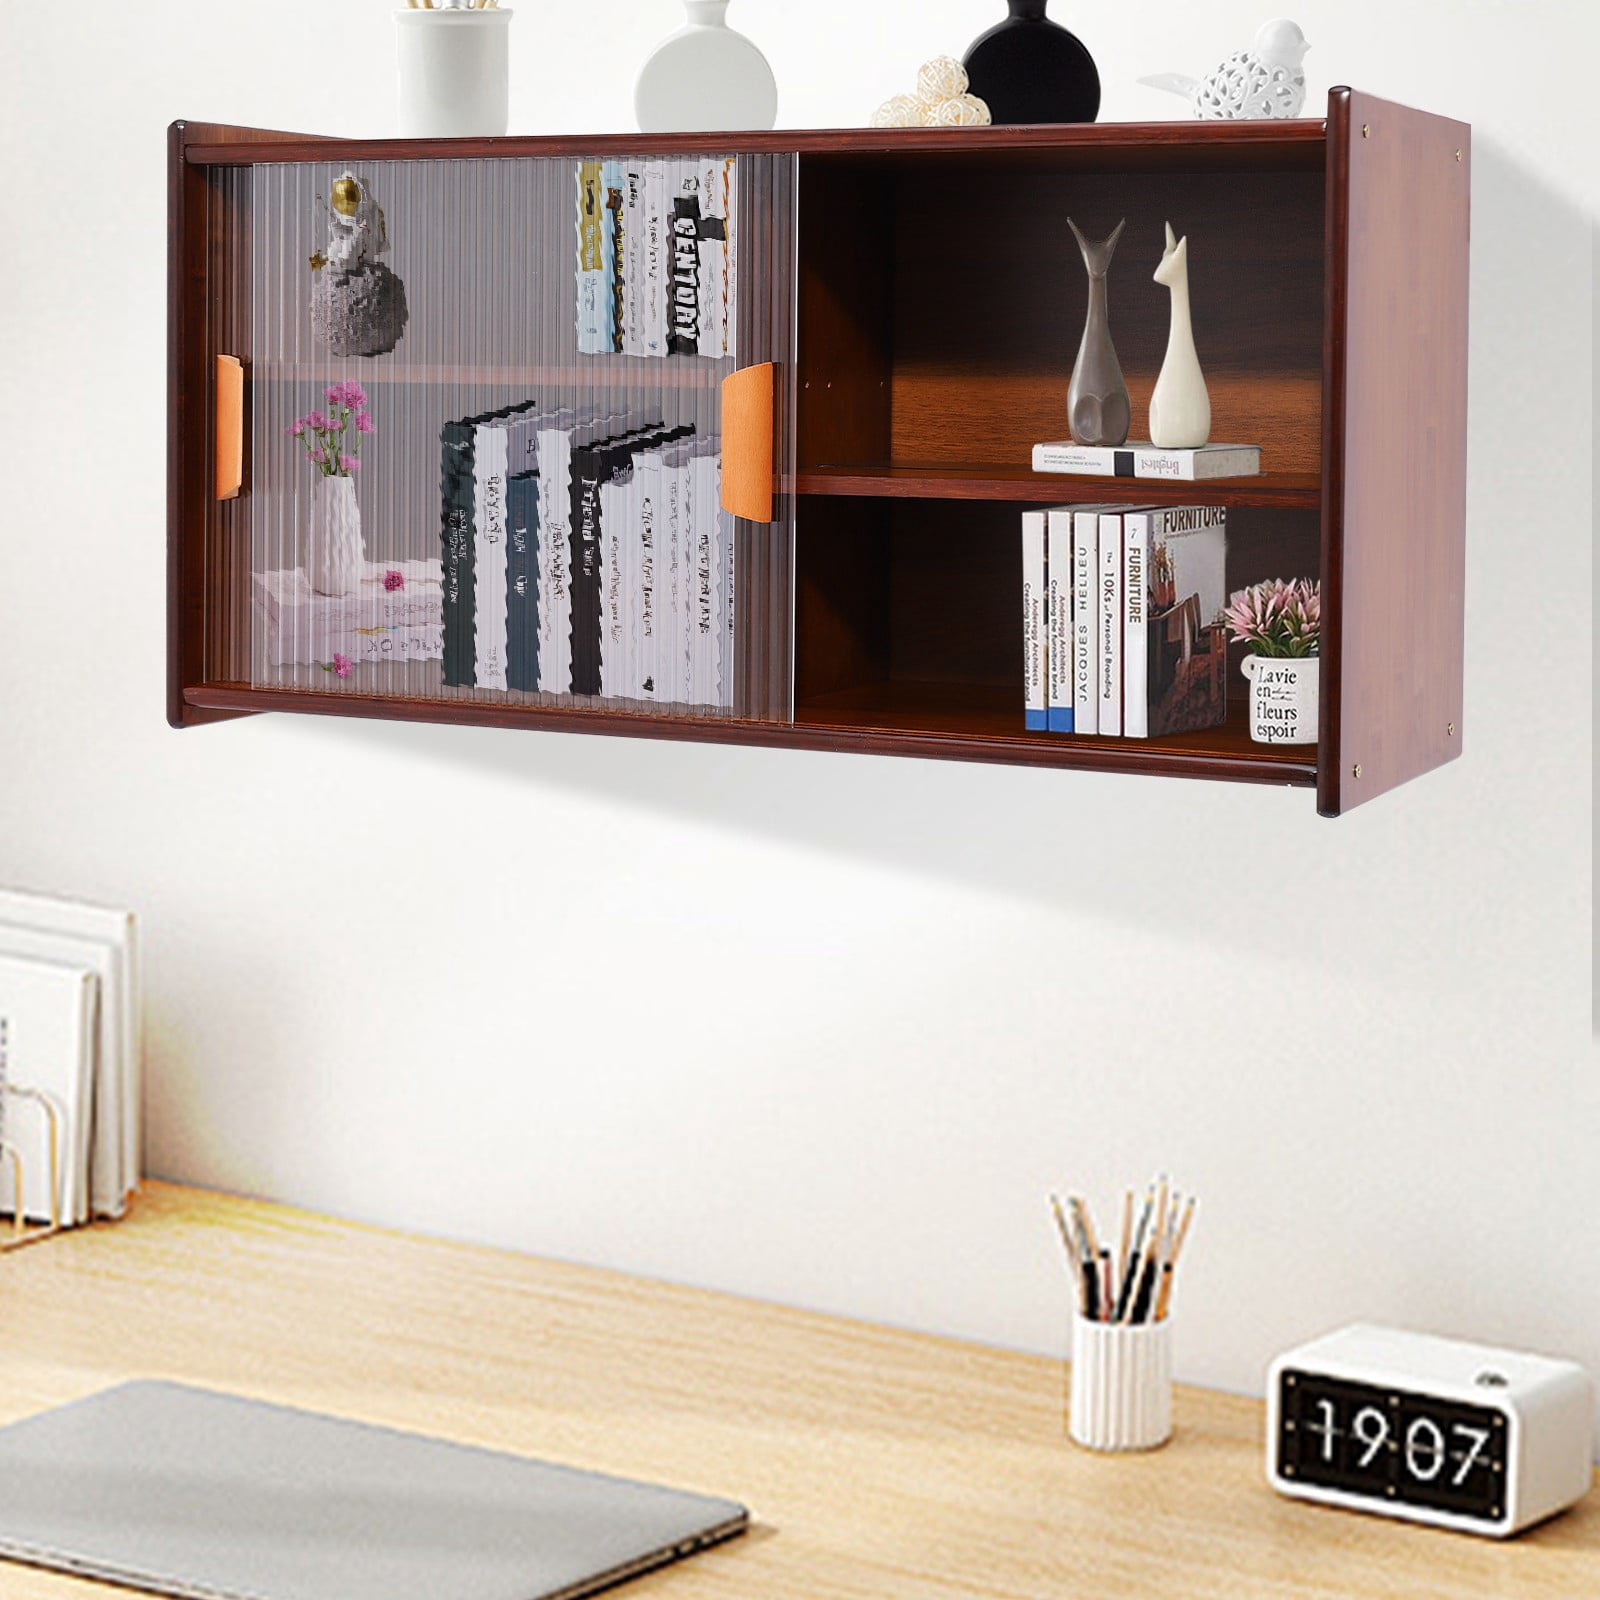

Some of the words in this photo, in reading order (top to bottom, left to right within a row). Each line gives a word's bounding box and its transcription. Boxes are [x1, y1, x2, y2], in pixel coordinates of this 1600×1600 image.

[1141, 456, 1180, 475] Brightest
[1164, 507, 1226, 533] FURNITURE
[1079, 547, 1087, 610] HELLEU
[1104, 572, 1114, 602] 10Ks
[1129, 547, 1141, 623] FURNITURE
[1079, 625, 1087, 702] JACQUES
[1104, 658, 1112, 699] Branding
[1257, 686, 1271, 698] en
[1257, 701, 1297, 719] fleurs
[1257, 722, 1297, 742] espoir
